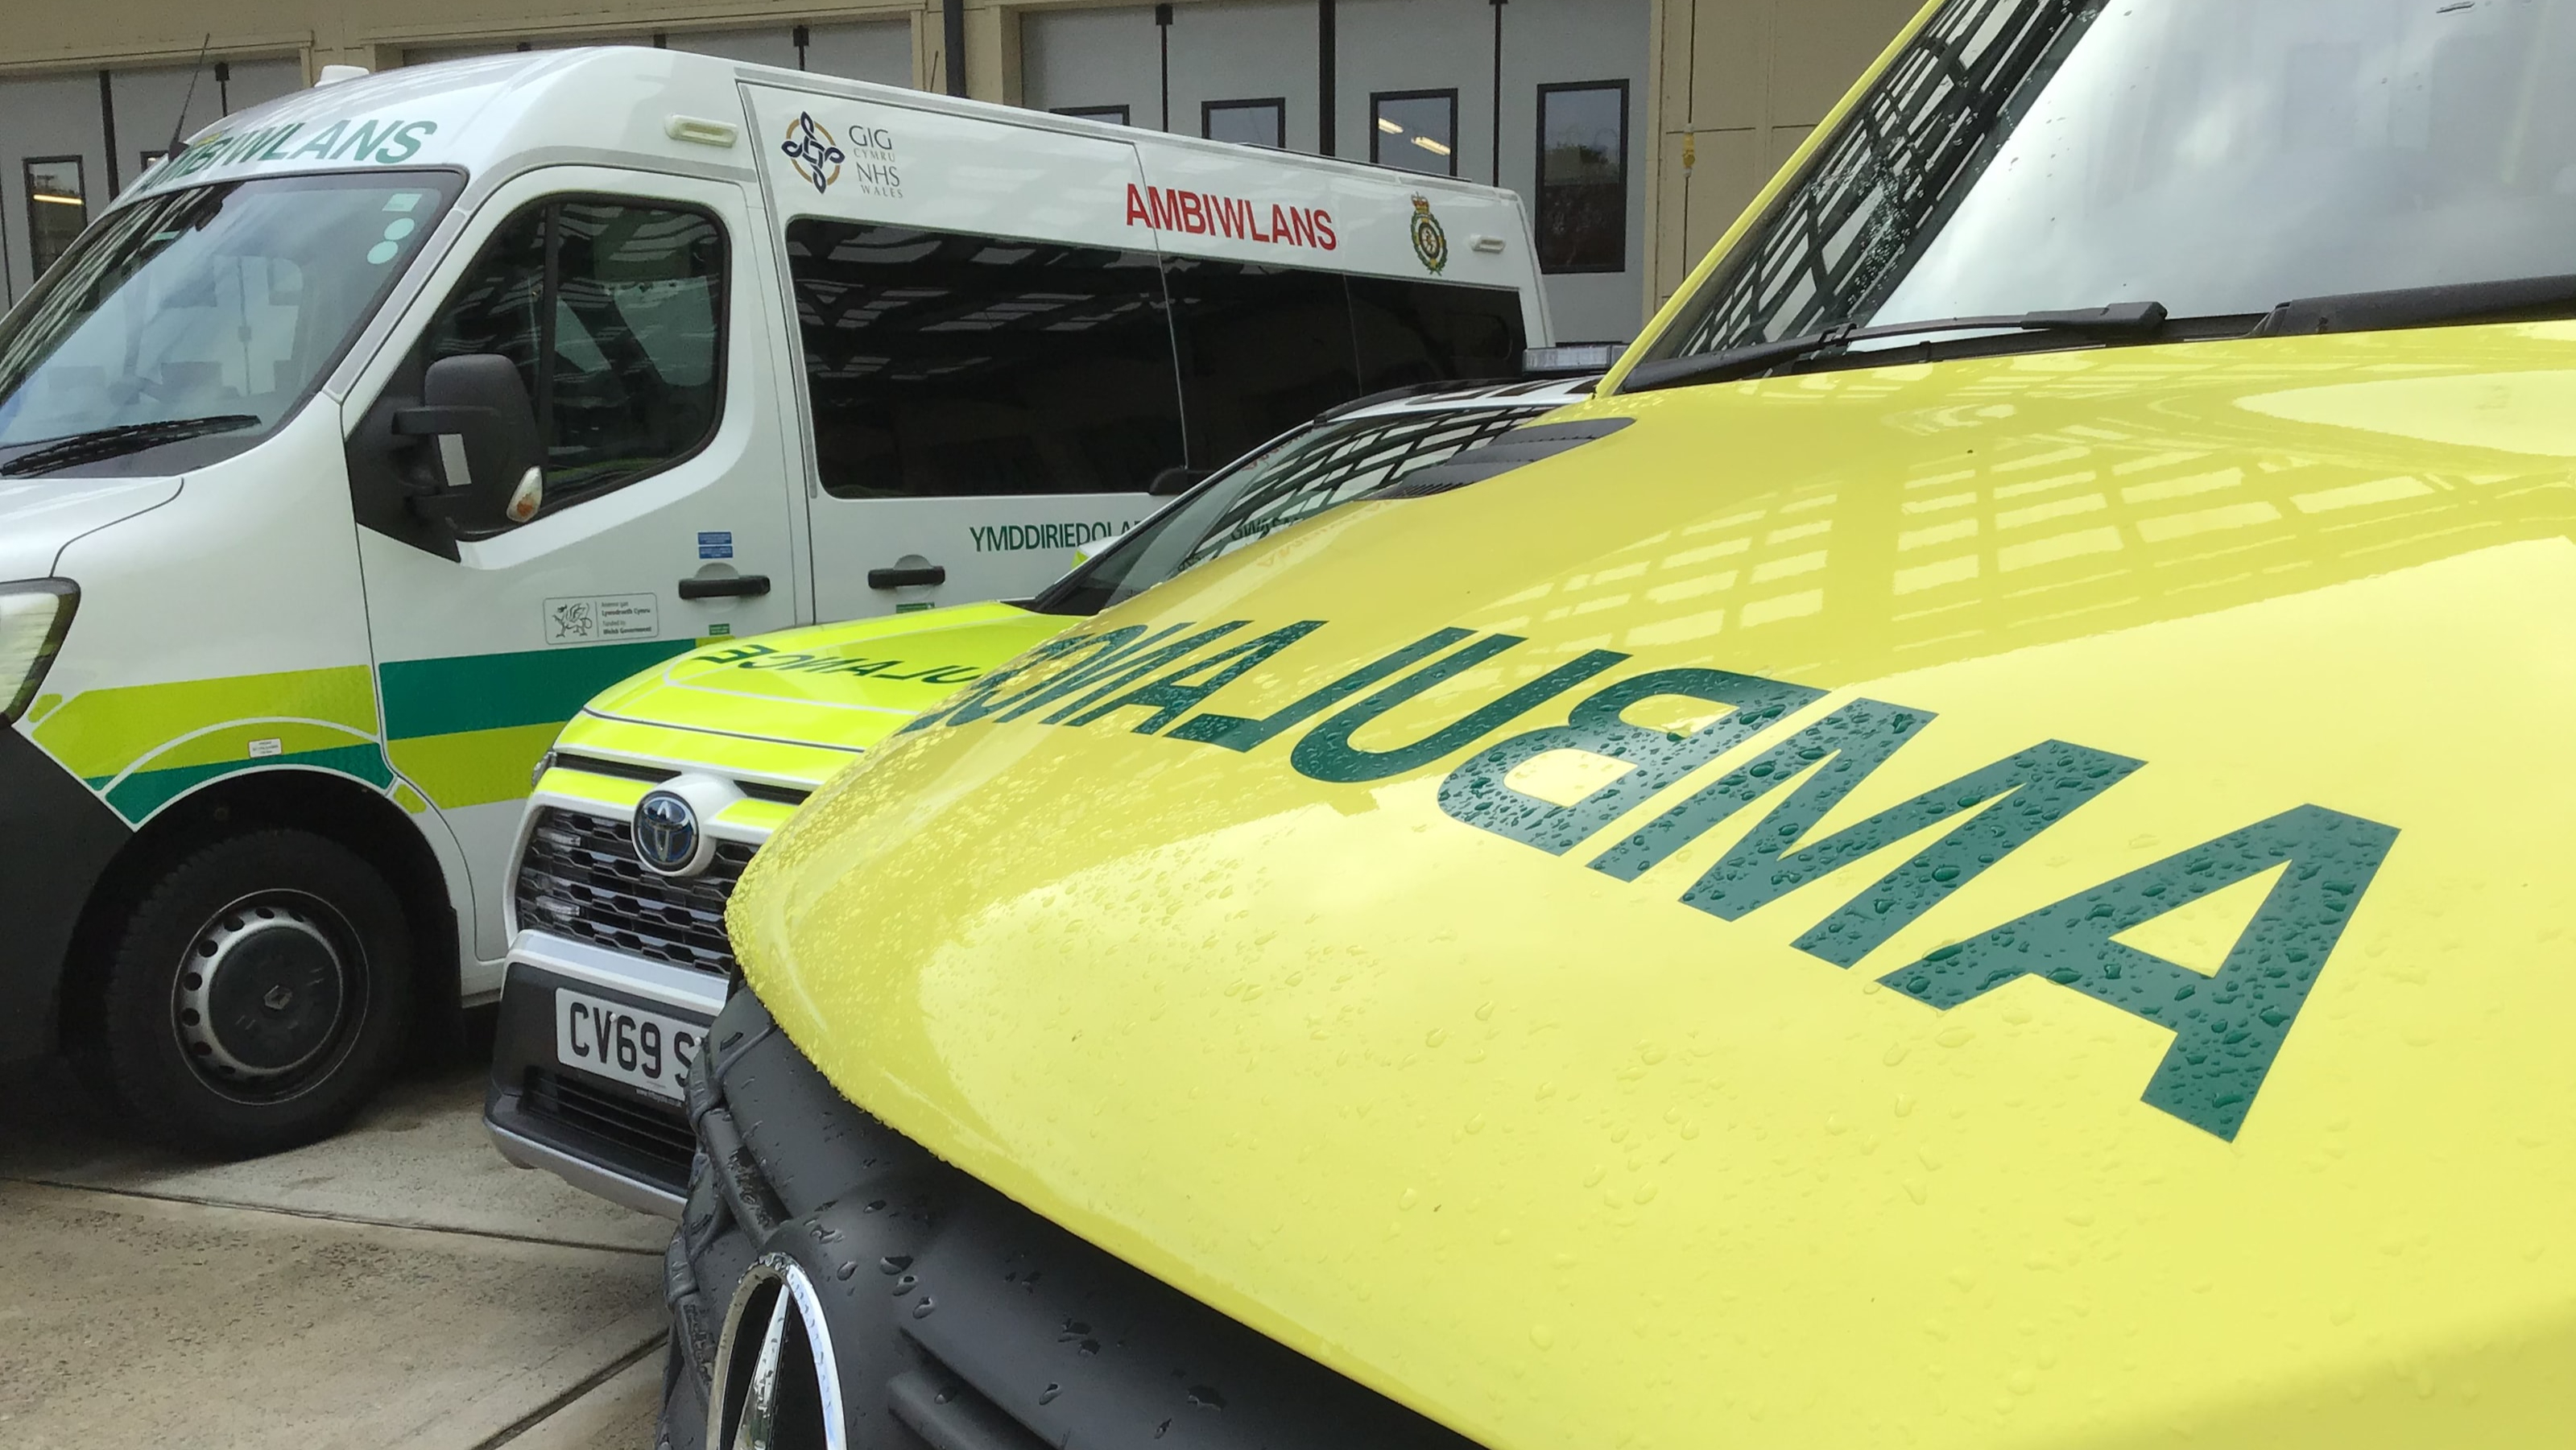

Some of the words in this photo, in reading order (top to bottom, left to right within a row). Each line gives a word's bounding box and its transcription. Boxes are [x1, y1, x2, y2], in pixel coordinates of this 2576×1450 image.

[849, 125, 892, 150] GIG
[854, 148, 895, 163] CYMRU
[856, 162, 899, 187] NHS
[861, 184, 903, 199] WALES
[1127, 183, 1337, 250] AMBIWLANS
[970, 520, 1142, 551] YMDDIRIEDOL
[570, 1002, 661, 1079] CV69
